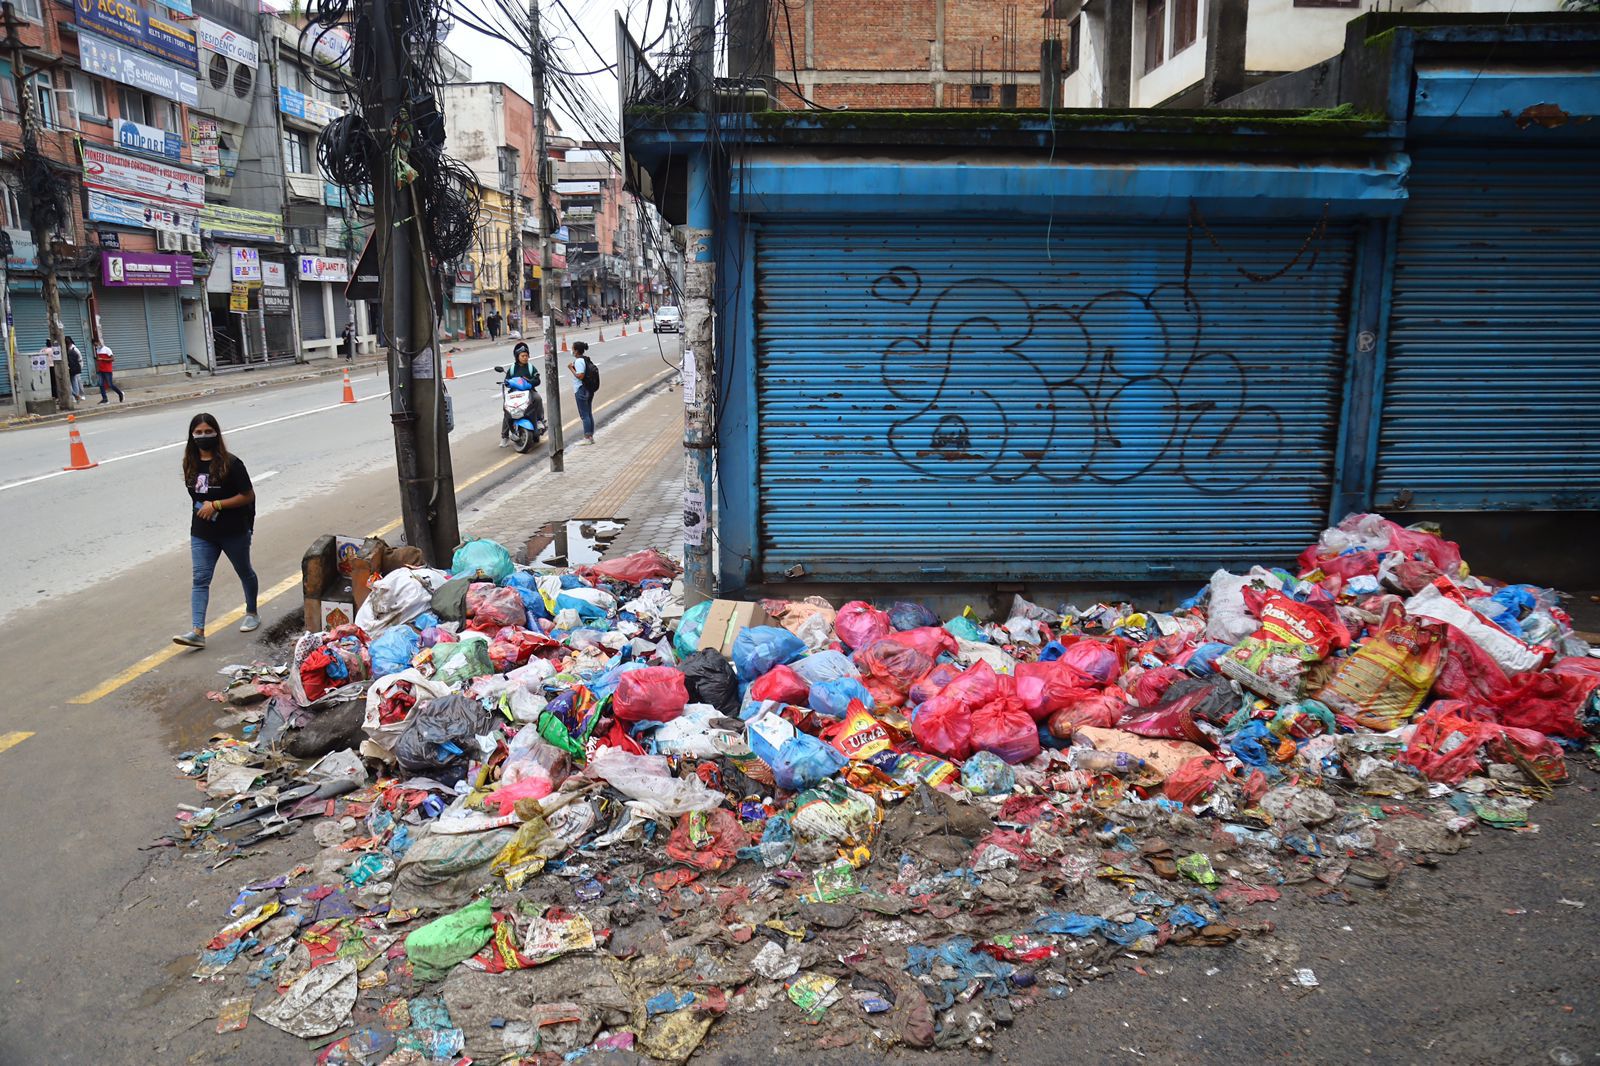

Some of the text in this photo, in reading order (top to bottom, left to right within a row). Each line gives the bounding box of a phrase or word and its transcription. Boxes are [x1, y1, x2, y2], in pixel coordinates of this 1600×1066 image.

[97, 0, 141, 26] ACCEL
[163, 34, 172, 43] PTE
[200, 31, 237, 54] RESIDENCY
[238, 48, 257, 63] GUIDE
[135, 69, 173, 89] e-HIGHWAY
[121, 131, 164, 154] EDUPORT
[16, 240, 32, 248] Nepa
[302, 259, 313, 273] BT
[322, 262, 339, 272] PLANET
[848, 726, 886, 748] URJA
